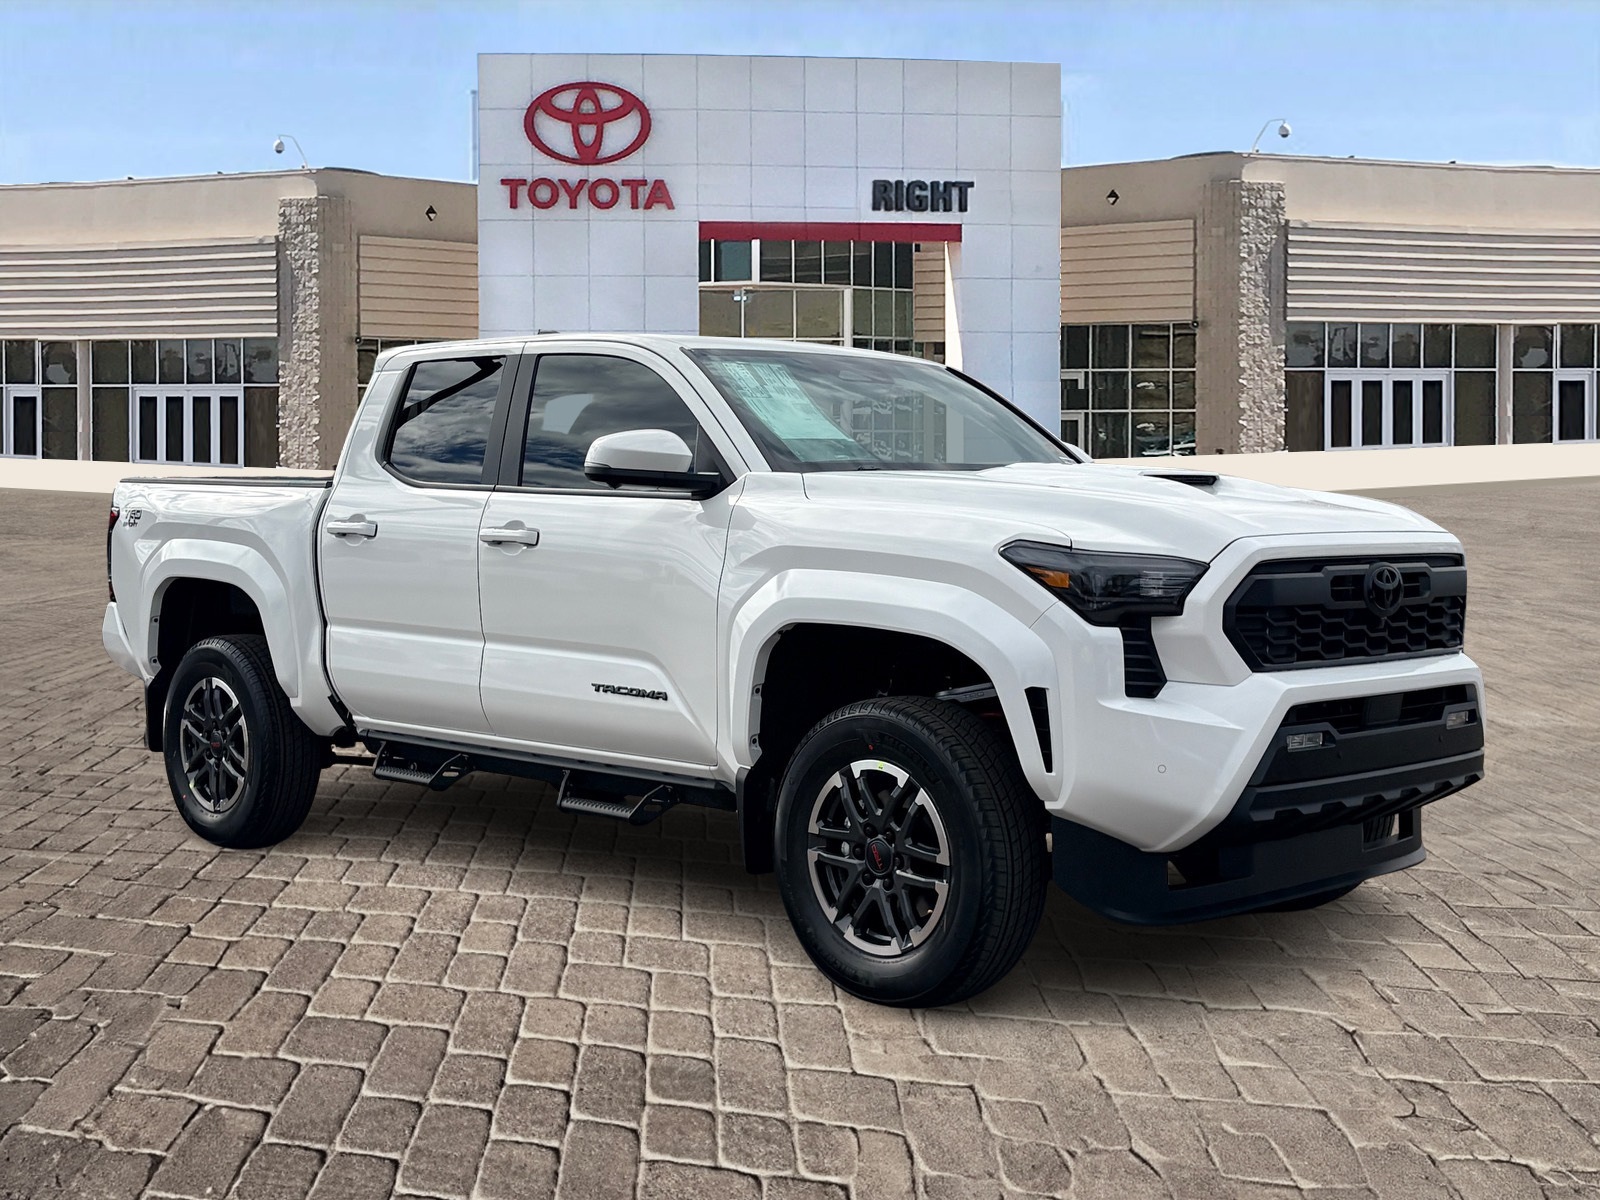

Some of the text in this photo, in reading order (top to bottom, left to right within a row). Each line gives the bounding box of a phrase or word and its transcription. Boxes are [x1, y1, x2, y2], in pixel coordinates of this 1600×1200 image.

[500, 178, 675, 209] TOYOTA
[872, 180, 975, 212] RIGHT
[591, 683, 668, 701] TACOMA
